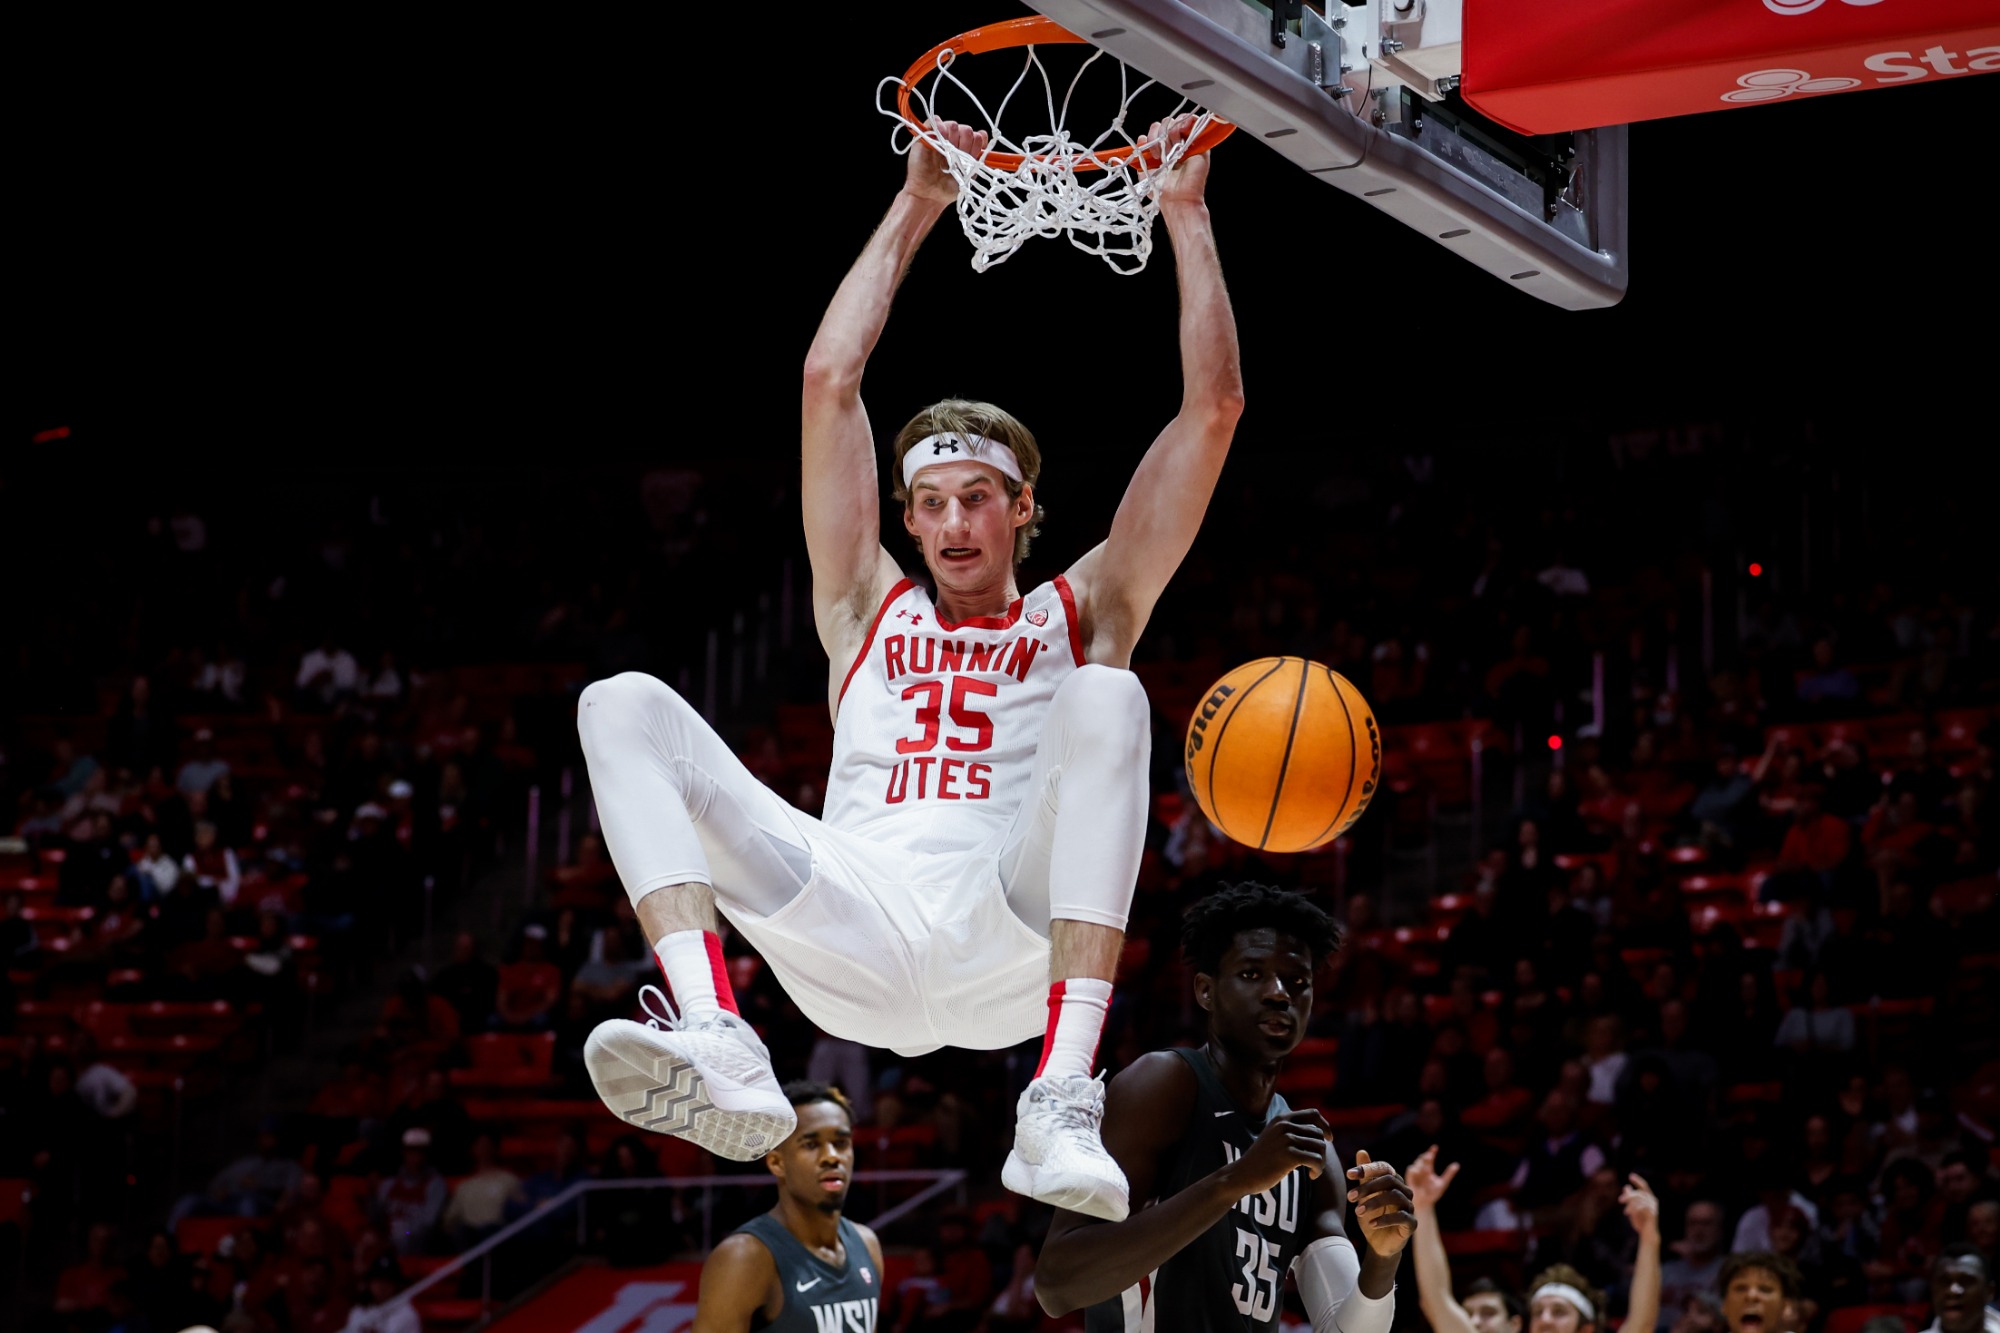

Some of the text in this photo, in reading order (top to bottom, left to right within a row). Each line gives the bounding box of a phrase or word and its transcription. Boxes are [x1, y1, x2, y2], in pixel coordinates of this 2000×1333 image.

[885, 634, 1048, 683] RUNNIN'
[896, 675, 997, 754] 35
[885, 756, 994, 804] UTES
[1231, 1226, 1281, 1323] 35
